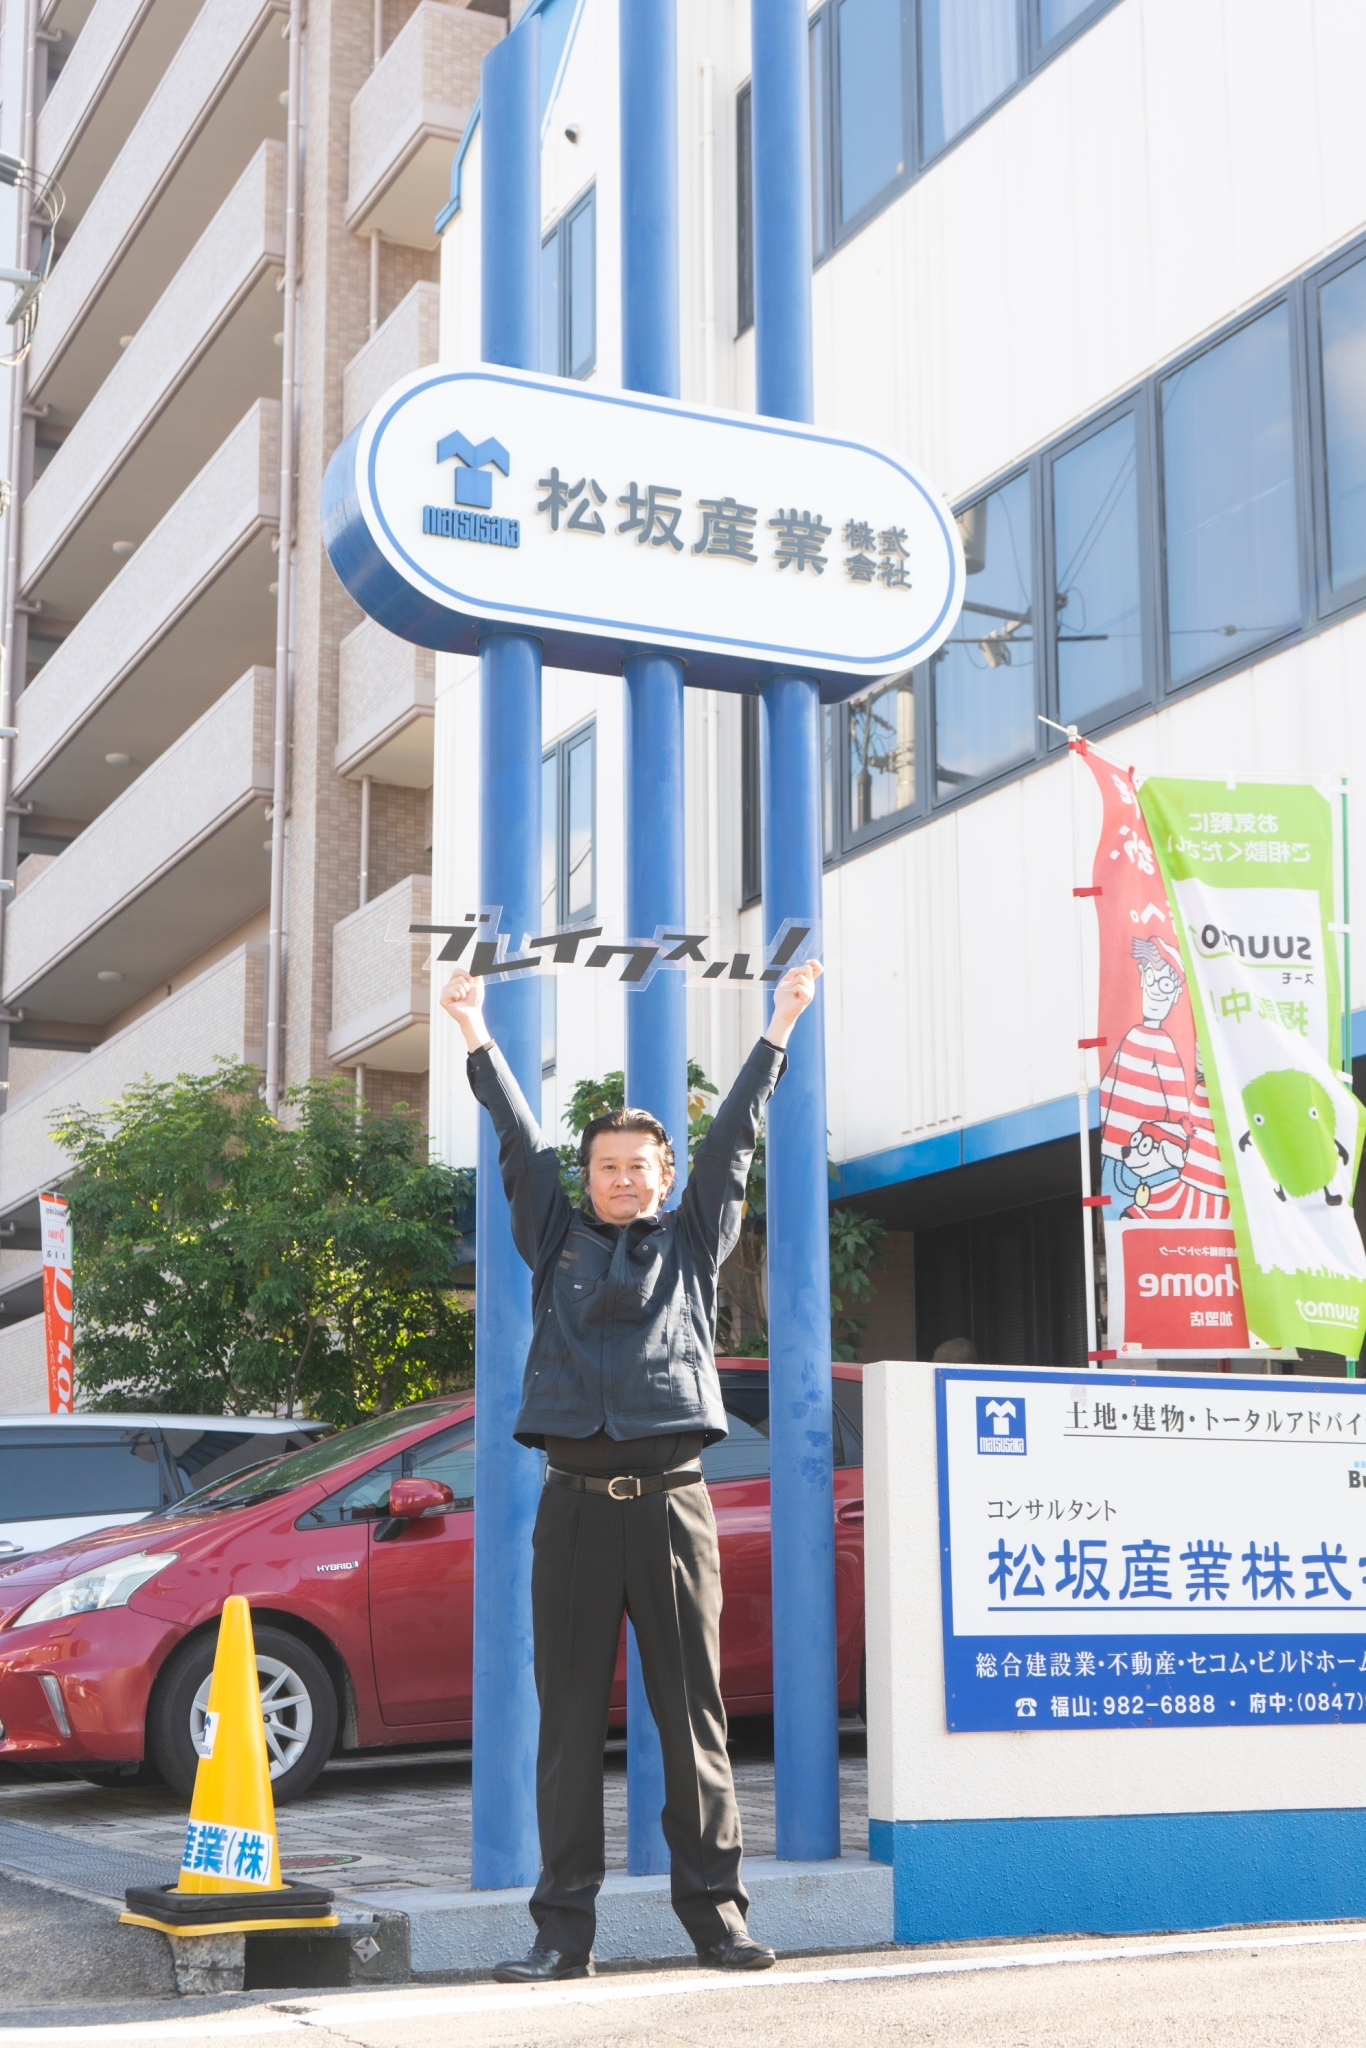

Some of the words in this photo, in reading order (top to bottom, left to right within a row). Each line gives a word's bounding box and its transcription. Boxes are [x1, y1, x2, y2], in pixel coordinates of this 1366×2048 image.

[536, 466, 833, 577] 松坂産業
[1064, 1401, 1366, 1436] 土地・建物・トータルアドバイ
[987, 1498, 1117, 1522] コンサルタント
[316, 1562, 353, 1573] HYBRID
[987, 1537, 1366, 1602] 松坂産業株式
[1249, 1691, 1366, 1715] 府中:(0847)
